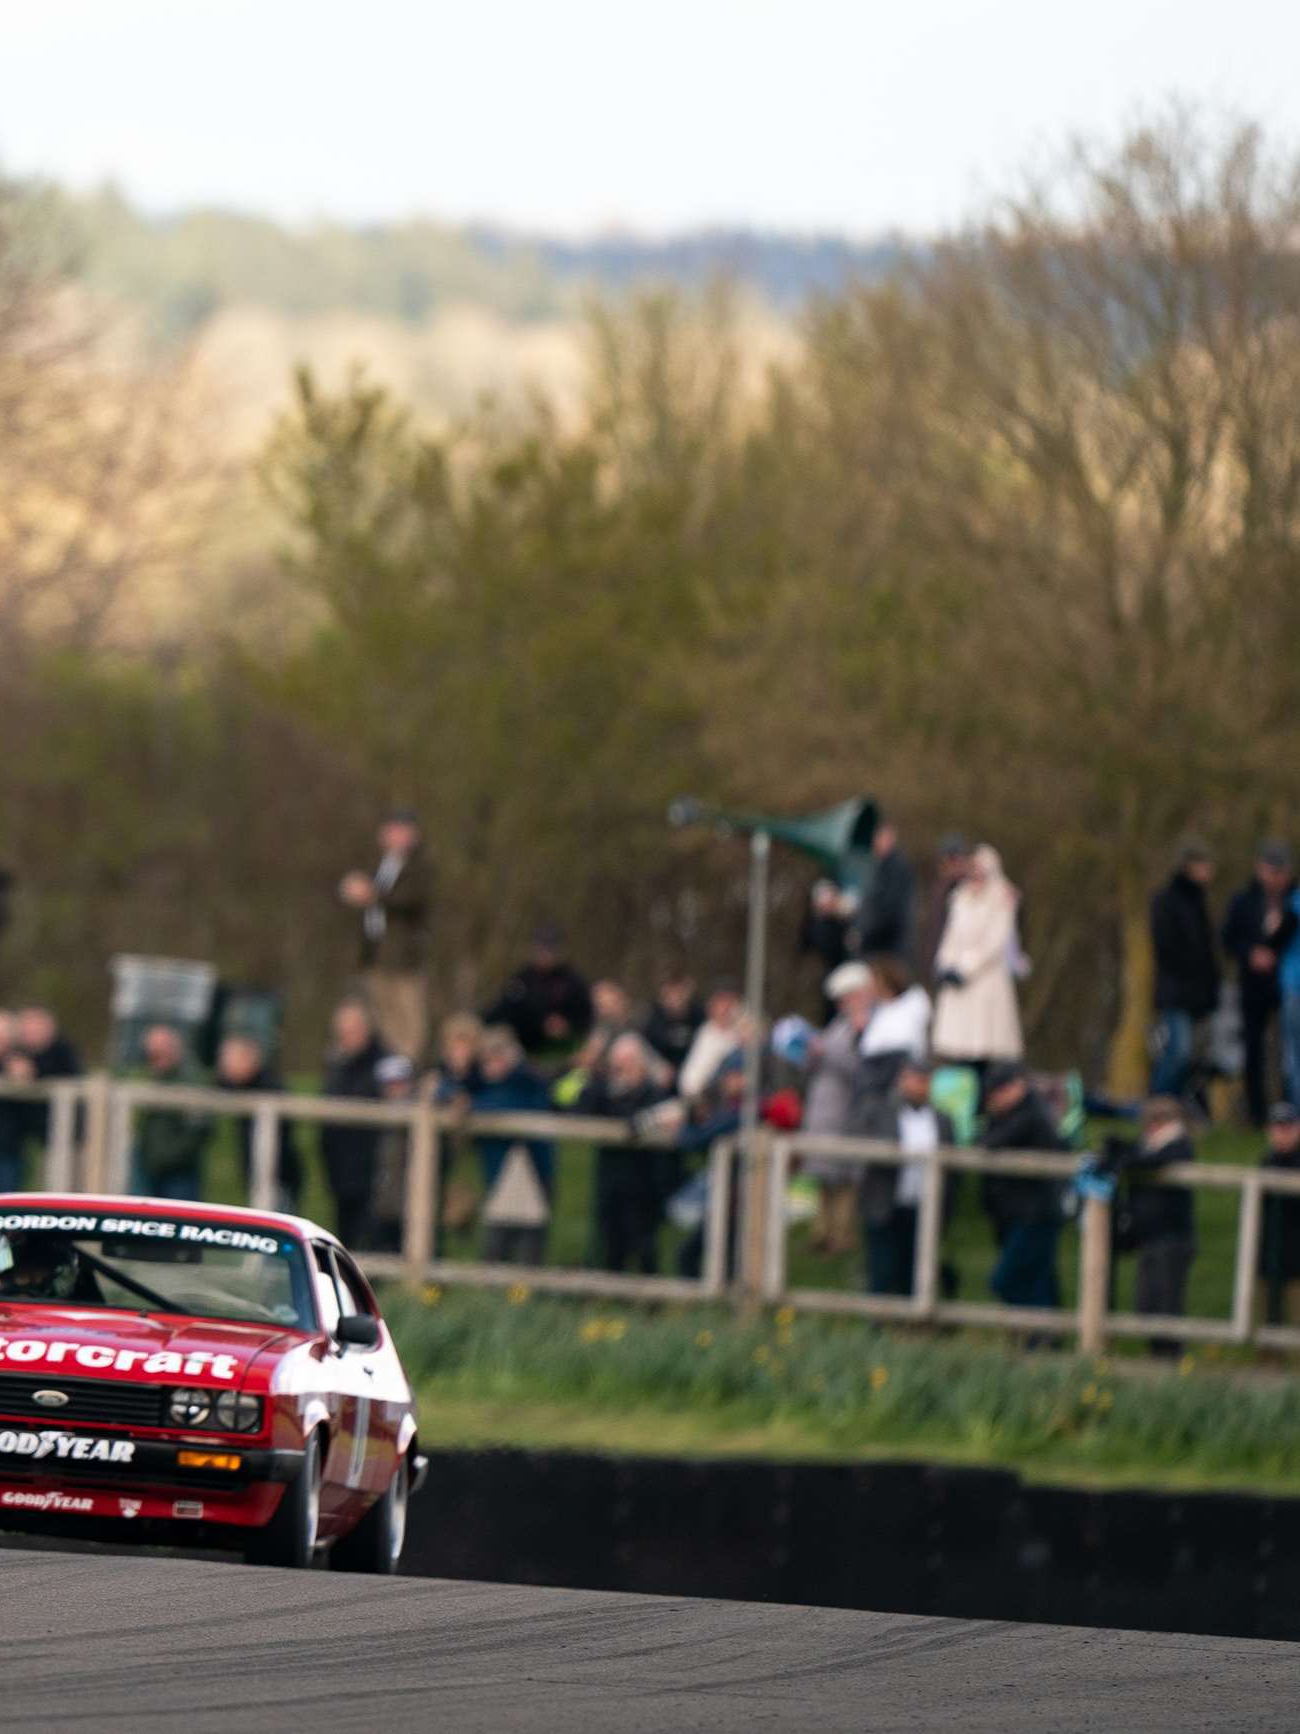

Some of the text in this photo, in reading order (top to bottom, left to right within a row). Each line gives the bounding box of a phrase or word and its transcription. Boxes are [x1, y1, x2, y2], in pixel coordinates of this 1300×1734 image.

[100, 1218, 176, 1238] SPICE
[180, 1225, 278, 1254] RACING
[1, 1491, 94, 1512] GOODYEAR
